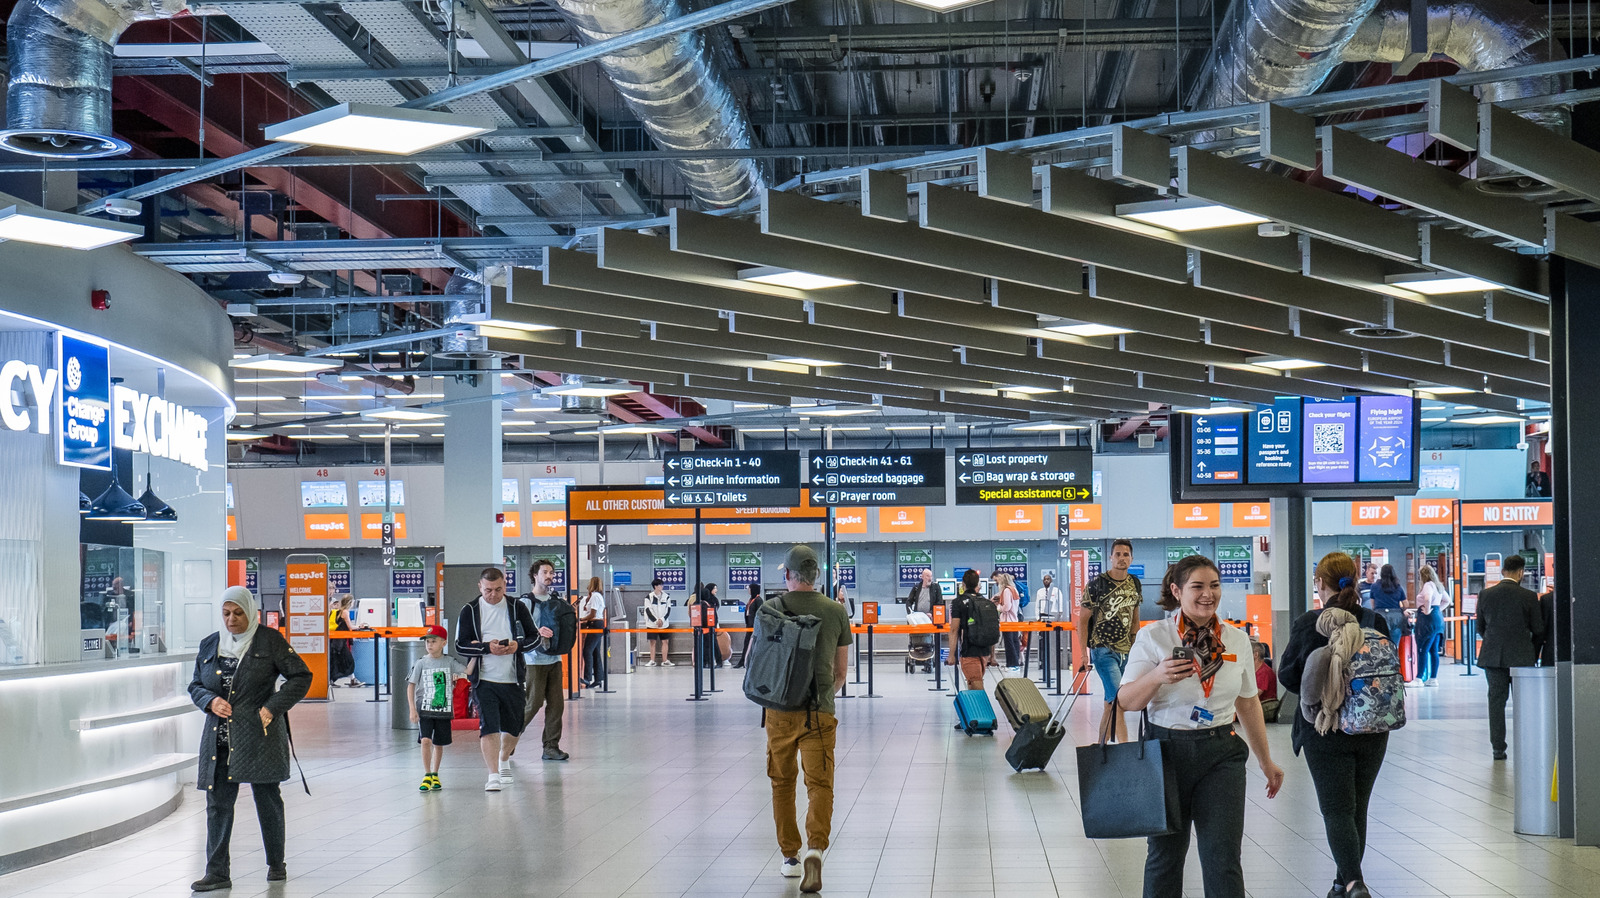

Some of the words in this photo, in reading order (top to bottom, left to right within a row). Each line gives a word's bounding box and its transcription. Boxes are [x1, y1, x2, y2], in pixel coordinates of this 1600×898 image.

[67, 396, 106, 426] Change
[67, 418, 98, 448] Group
[114, 385, 208, 471] EXCHANGE
[840, 456, 878, 466] Check-in
[880, 456, 891, 465] 41
[900, 456, 912, 466] 61
[986, 455, 1006, 464] Lost
[1008, 455, 1048, 465] property
[1432, 452, 1442, 460] 61
[695, 458, 733, 468] Check-in
[735, 458, 740, 467] 1
[749, 458, 761, 467] 40
[695, 476, 723, 485] Airline
[726, 475, 780, 485] information
[840, 474, 884, 484] Oversized
[886, 474, 924, 485] baggage
[986, 472, 1004, 483] Bag
[1006, 473, 1029, 483] wrap
[1030, 472, 1037, 481] &
[1039, 472, 1075, 482] storage
[716, 493, 747, 502] Toilets
[840, 492, 870, 502] Prayer
[979, 489, 1012, 501] Special
[1014, 488, 1062, 499] assistance
[586, 500, 601, 511] ALL
[602, 500, 629, 510] OTHER
[631, 499, 664, 510] CUSTOM
[1359, 506, 1381, 519] EXIT
[1419, 505, 1441, 518] EXIT
[1484, 506, 1500, 521] NO
[1503, 506, 1540, 521] ENTRY
[537, 519, 566, 528] easyJe
[1061, 516, 1067, 525] 3
[310, 522, 344, 531] easyJet
[384, 524, 390, 534] 9
[1061, 538, 1068, 547] 4
[598, 544, 605, 553] 8
[289, 571, 324, 580] easyJet
